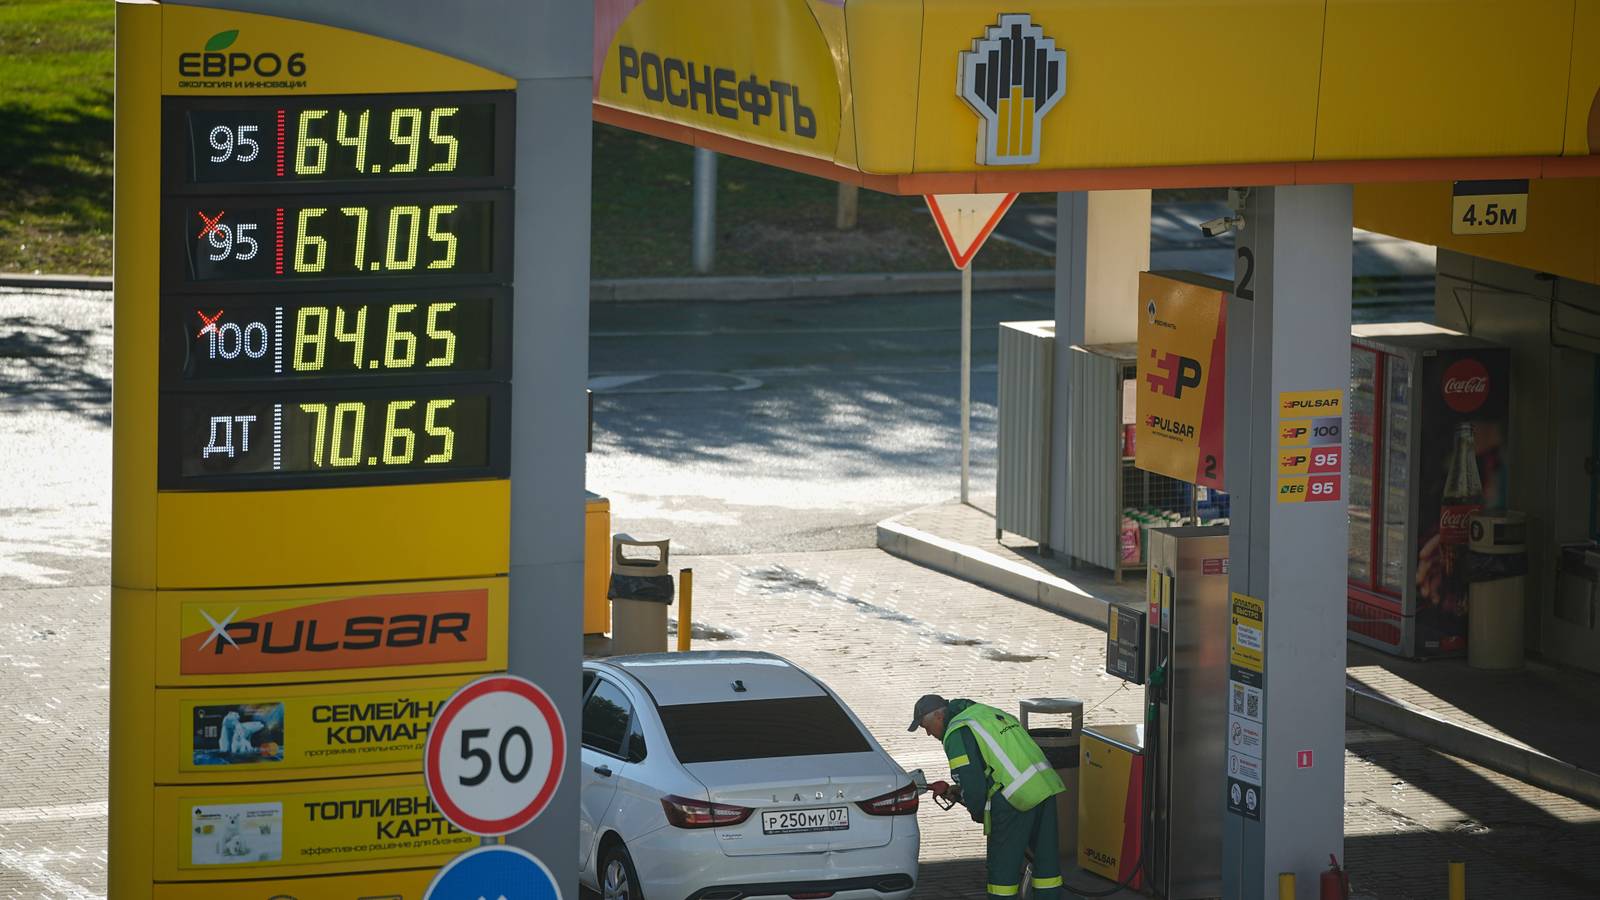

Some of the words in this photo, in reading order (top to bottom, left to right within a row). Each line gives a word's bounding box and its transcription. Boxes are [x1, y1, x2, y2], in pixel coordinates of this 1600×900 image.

[178, 52, 282, 77] ЕВРО
[287, 52, 306, 77] 6
[618, 45, 817, 140] РОСНЕФТЬ
[209, 125, 259, 163] 95
[295, 107, 459, 175] 64.95
[208, 223, 258, 261] 95
[294, 204, 458, 273] 67.05
[1236, 246, 1254, 301] 2
[200, 321, 268, 359] 100
[293, 302, 457, 371] 84.65
[1291, 399, 1339, 409] PULSAR
[203, 415, 257, 458] ДТ
[299, 399, 456, 468] 70.65
[1151, 416, 1195, 438] PULSAR
[1313, 425, 1339, 437] 100
[1205, 454, 1217, 479] 2
[1315, 453, 1338, 466] 95
[1311, 482, 1334, 495] 95
[459, 726, 533, 787] 50
[772, 790, 844, 803] LADA
